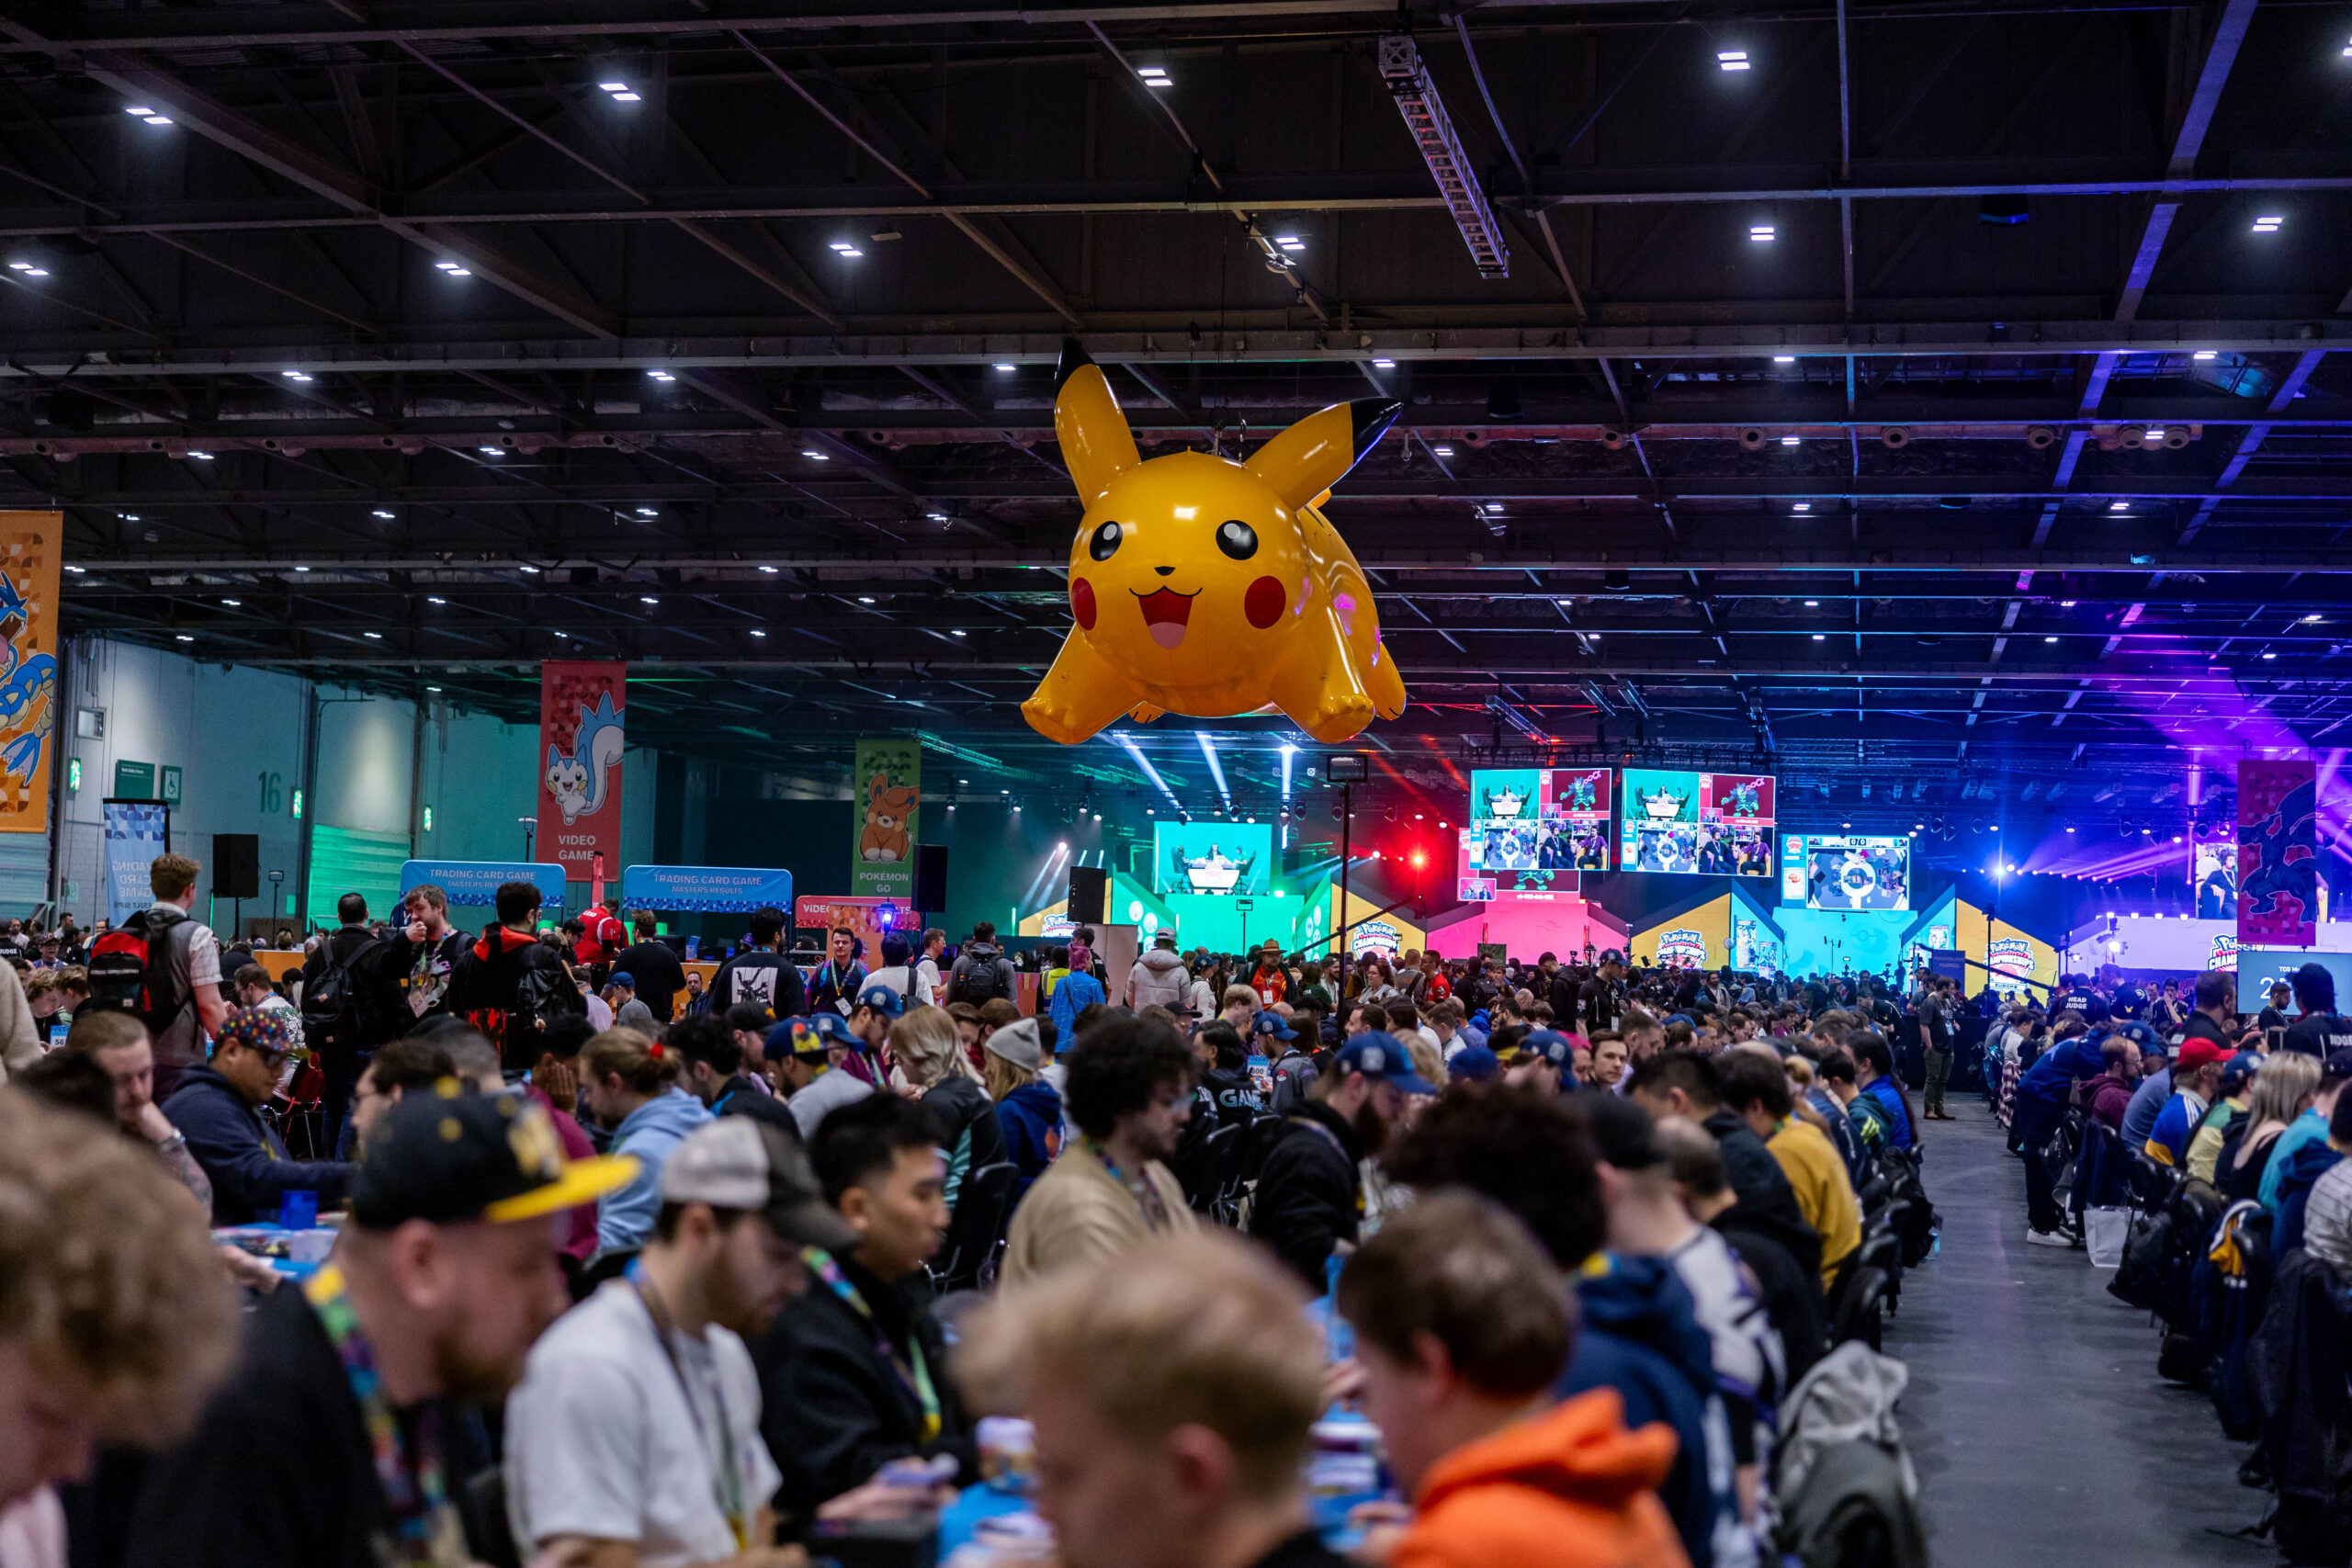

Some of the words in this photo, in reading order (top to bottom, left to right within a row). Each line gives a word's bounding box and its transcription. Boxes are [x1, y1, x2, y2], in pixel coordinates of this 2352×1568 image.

[258, 771, 281, 814] 16
[559, 835, 596, 846] VIDEO
[559, 850, 594, 861] GAME
[430, 869, 473, 879] TRADING
[476, 870, 504, 880] CARD
[506, 871, 536, 881] GAME
[653, 874, 698, 885] TRADING
[701, 875, 730, 886] CARD
[732, 876, 763, 886] GAME
[859, 871, 910, 882] POKÉMON
[447, 880, 483, 888] MASTERS
[876, 884, 891, 893] GO
[672, 886, 708, 894] MASTERS
[709, 886, 743, 895] RESULTS
